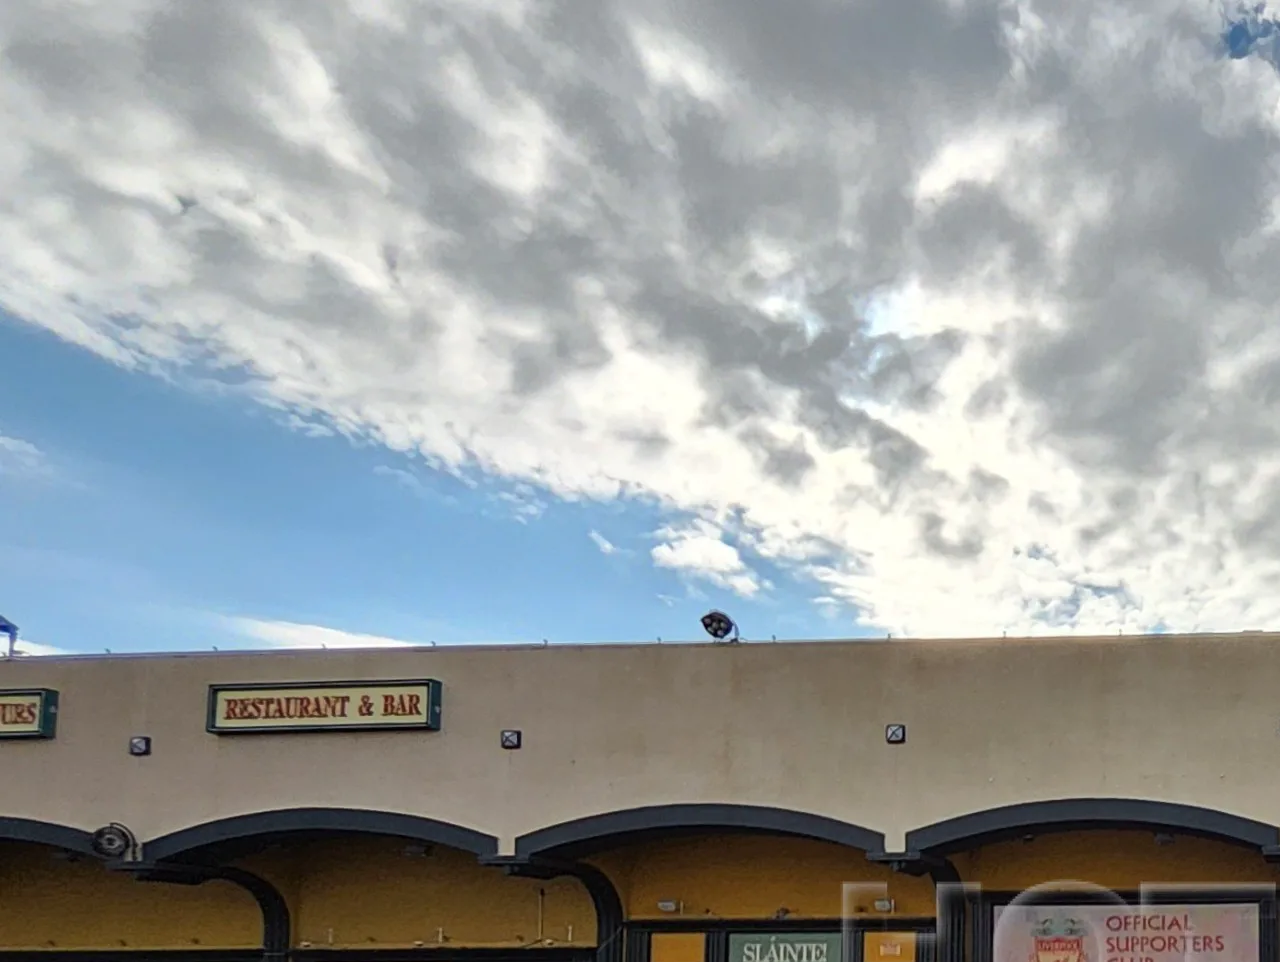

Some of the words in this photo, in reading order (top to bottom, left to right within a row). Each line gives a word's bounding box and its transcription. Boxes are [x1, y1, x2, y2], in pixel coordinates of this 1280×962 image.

[224, 695, 350, 720] RESTAURANT
[358, 695, 374, 716] &
[381, 693, 422, 716] BAR
[1106, 914, 1192, 931] OFFICIAL
[1106, 936, 1225, 953] SUPPORTERS
